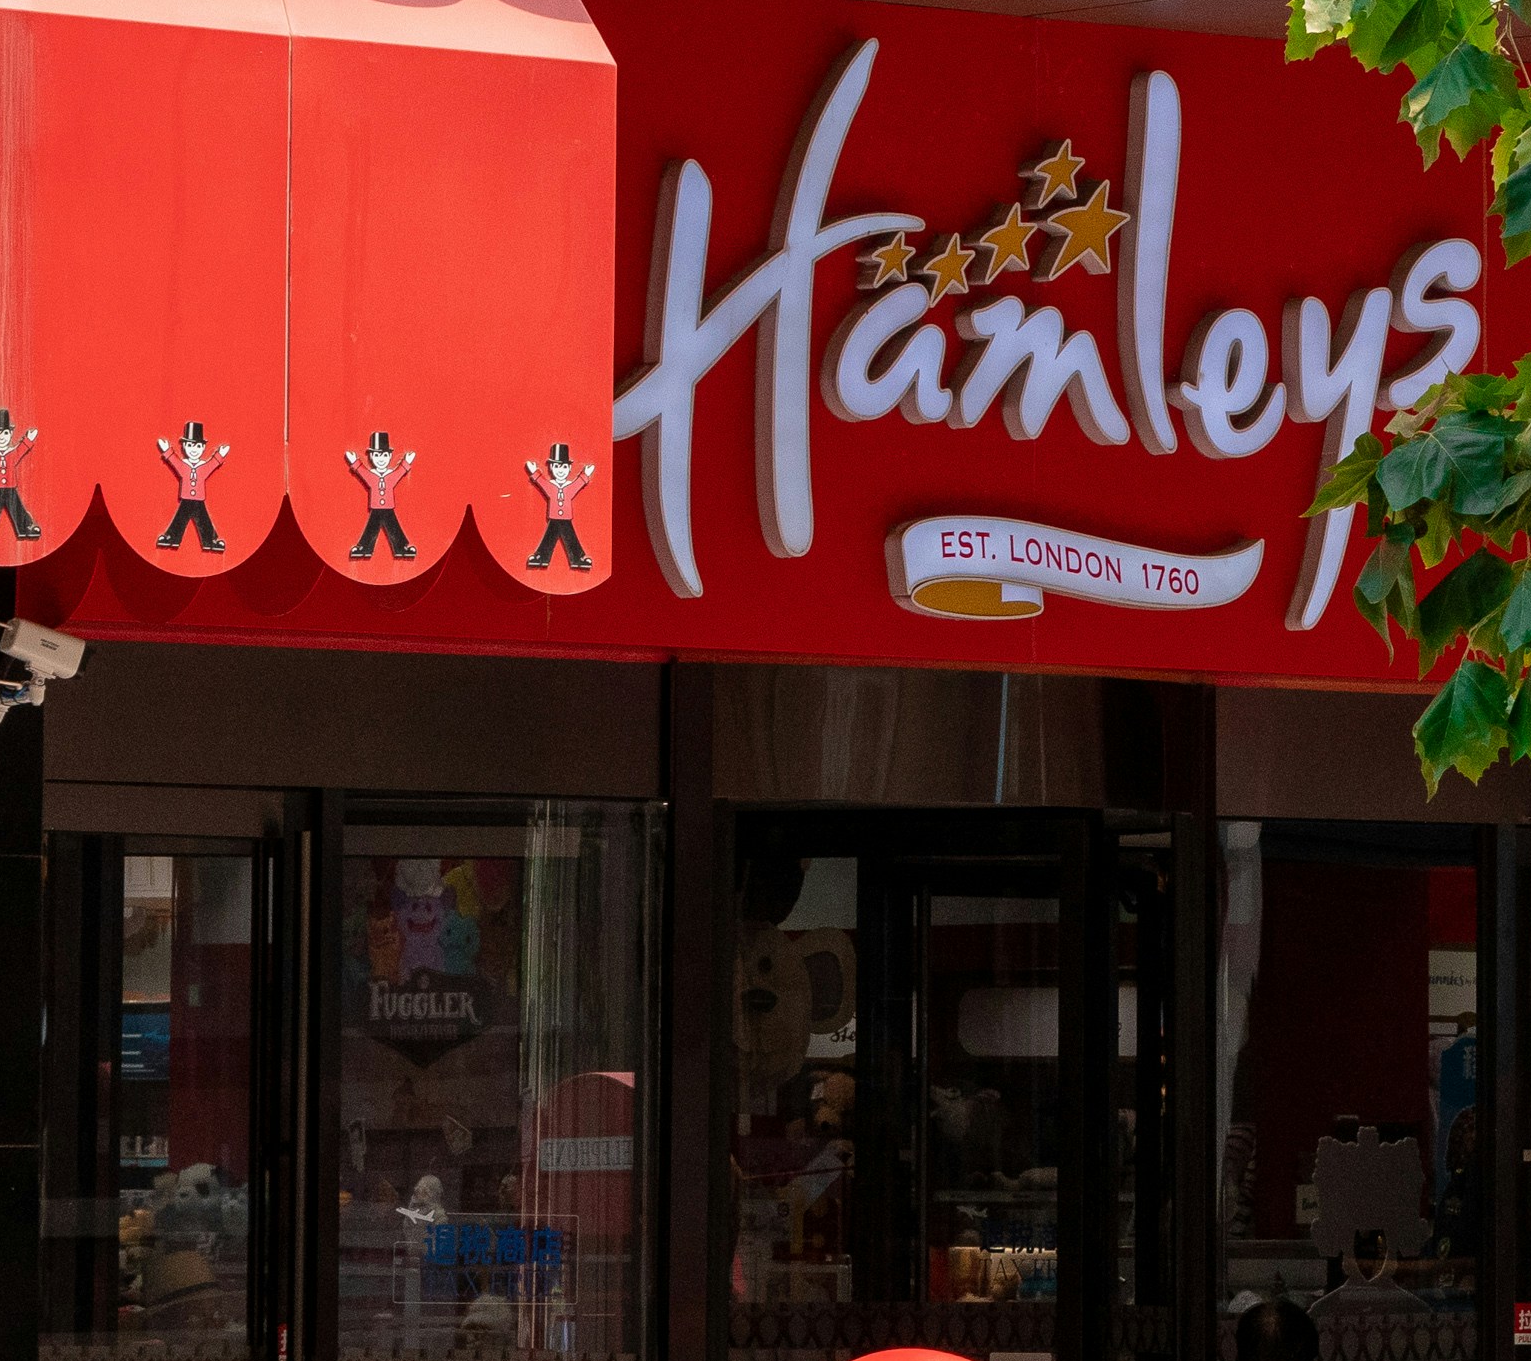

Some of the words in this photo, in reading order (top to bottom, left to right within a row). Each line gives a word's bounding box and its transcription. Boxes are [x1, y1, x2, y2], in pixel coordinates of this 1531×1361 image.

[615, 38, 1482, 630] Hamleys
[940, 530, 998, 561] EST.
[1010, 539, 1123, 585] LONDON
[1141, 561, 1200, 596] 1760
[367, 980, 483, 1026] FUGGLER
[423, 1223, 563, 1266] 退税商店
[981, 1218, 1057, 1253] 退税商
